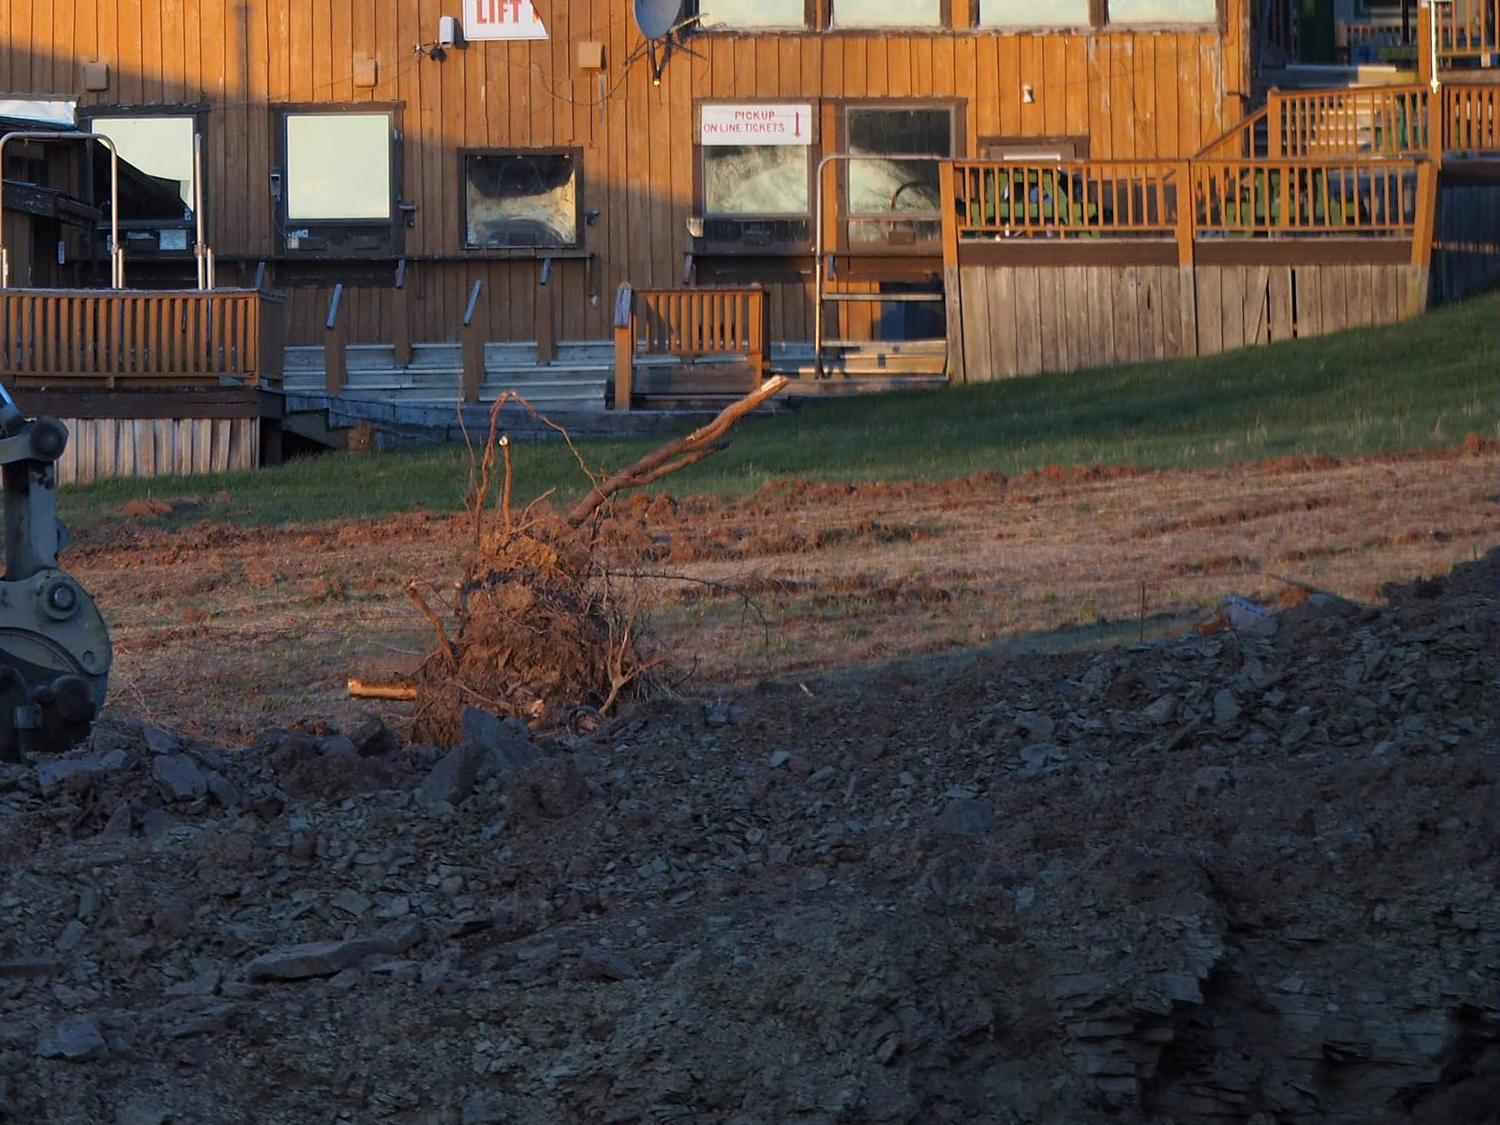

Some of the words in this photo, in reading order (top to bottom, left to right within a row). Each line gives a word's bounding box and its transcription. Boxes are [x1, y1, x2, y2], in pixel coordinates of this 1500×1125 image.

[476, 0, 522, 25] LIFT
[734, 111, 776, 121] PICKUP
[745, 123, 786, 133] TICKETS
